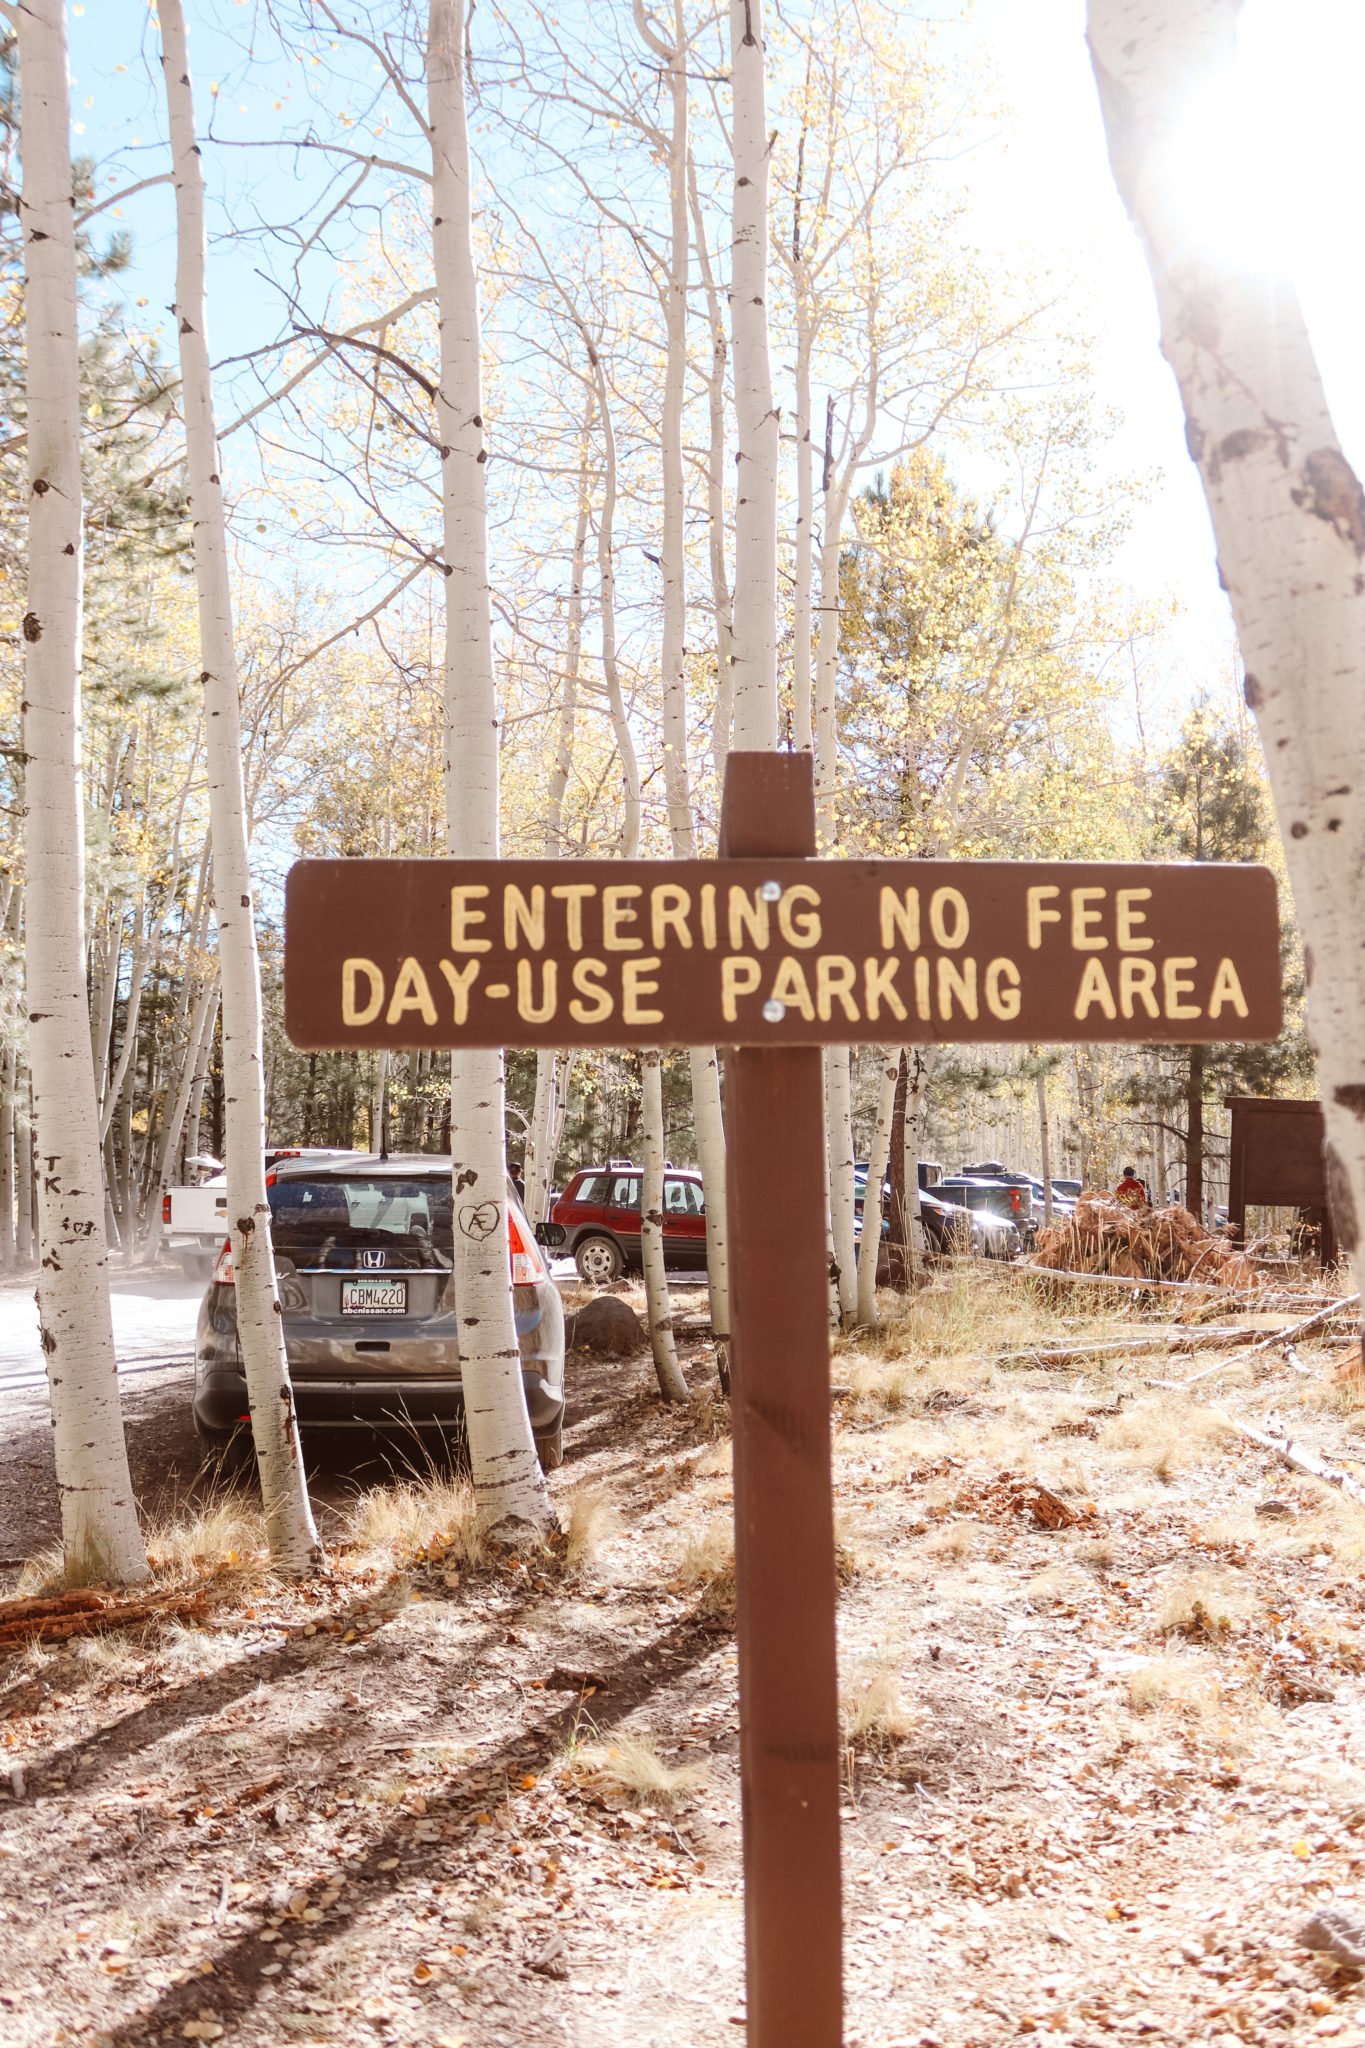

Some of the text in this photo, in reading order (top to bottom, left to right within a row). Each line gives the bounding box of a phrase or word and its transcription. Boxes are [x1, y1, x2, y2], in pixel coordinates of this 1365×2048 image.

[450, 883, 1155, 952] ENTERING NO FEE
[341, 955, 1249, 1026] DAY-USE PARKING AREA
[350, 1289, 404, 1305] CBM4220
